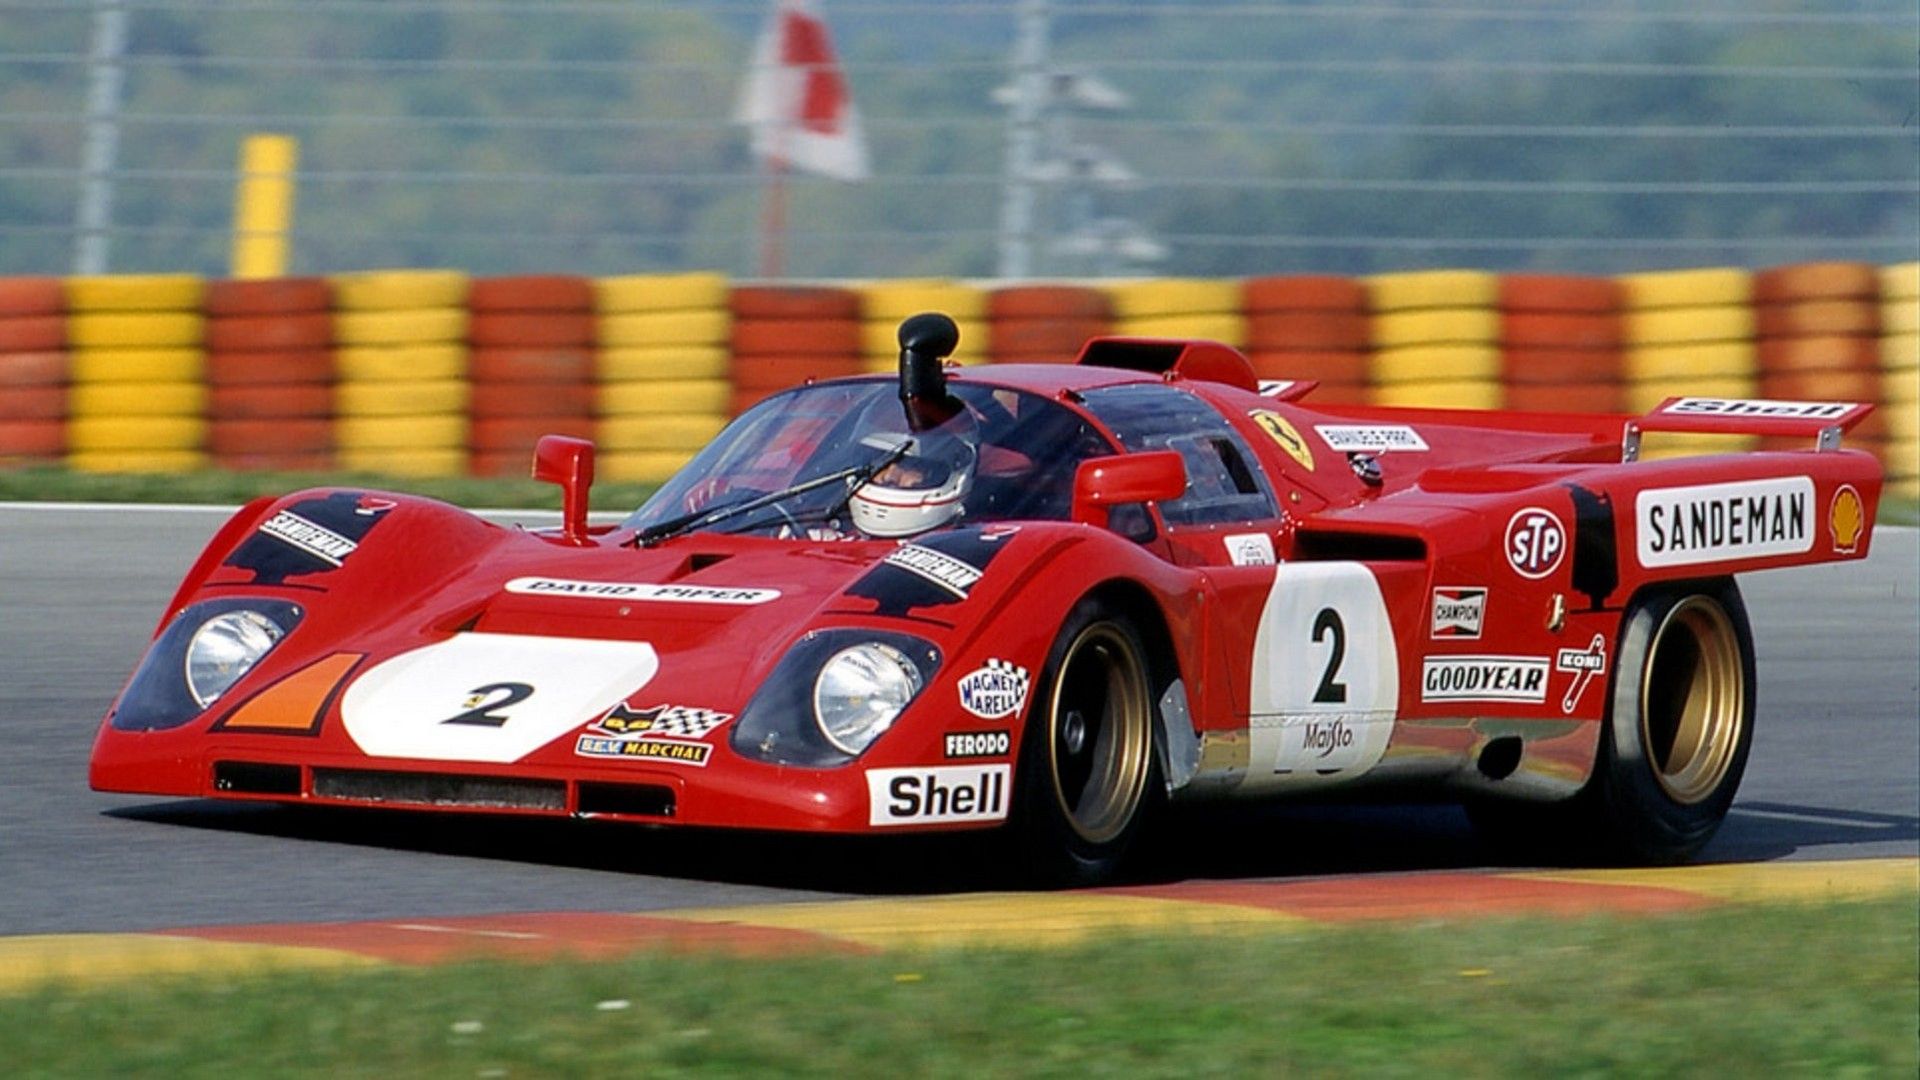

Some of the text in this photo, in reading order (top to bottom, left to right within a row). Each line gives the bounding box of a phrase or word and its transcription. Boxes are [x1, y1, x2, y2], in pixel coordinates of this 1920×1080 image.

[1677, 400, 1845, 416] Shell
[1650, 493, 1805, 553] SANDEMAN
[1513, 516, 1560, 569] STP
[527, 580, 761, 600] DAVID PIPER
[1436, 604, 1478, 621] CHAMPION
[1312, 607, 1346, 703] 2
[1562, 653, 1601, 668] KONI
[1426, 666, 1543, 691] GOODYEAR
[440, 682, 535, 727] 2
[946, 733, 1009, 756] FERODO
[1303, 716, 1354, 758] Maisto
[623, 741, 703, 762] MARCHAL
[889, 772, 1003, 818] Shell
